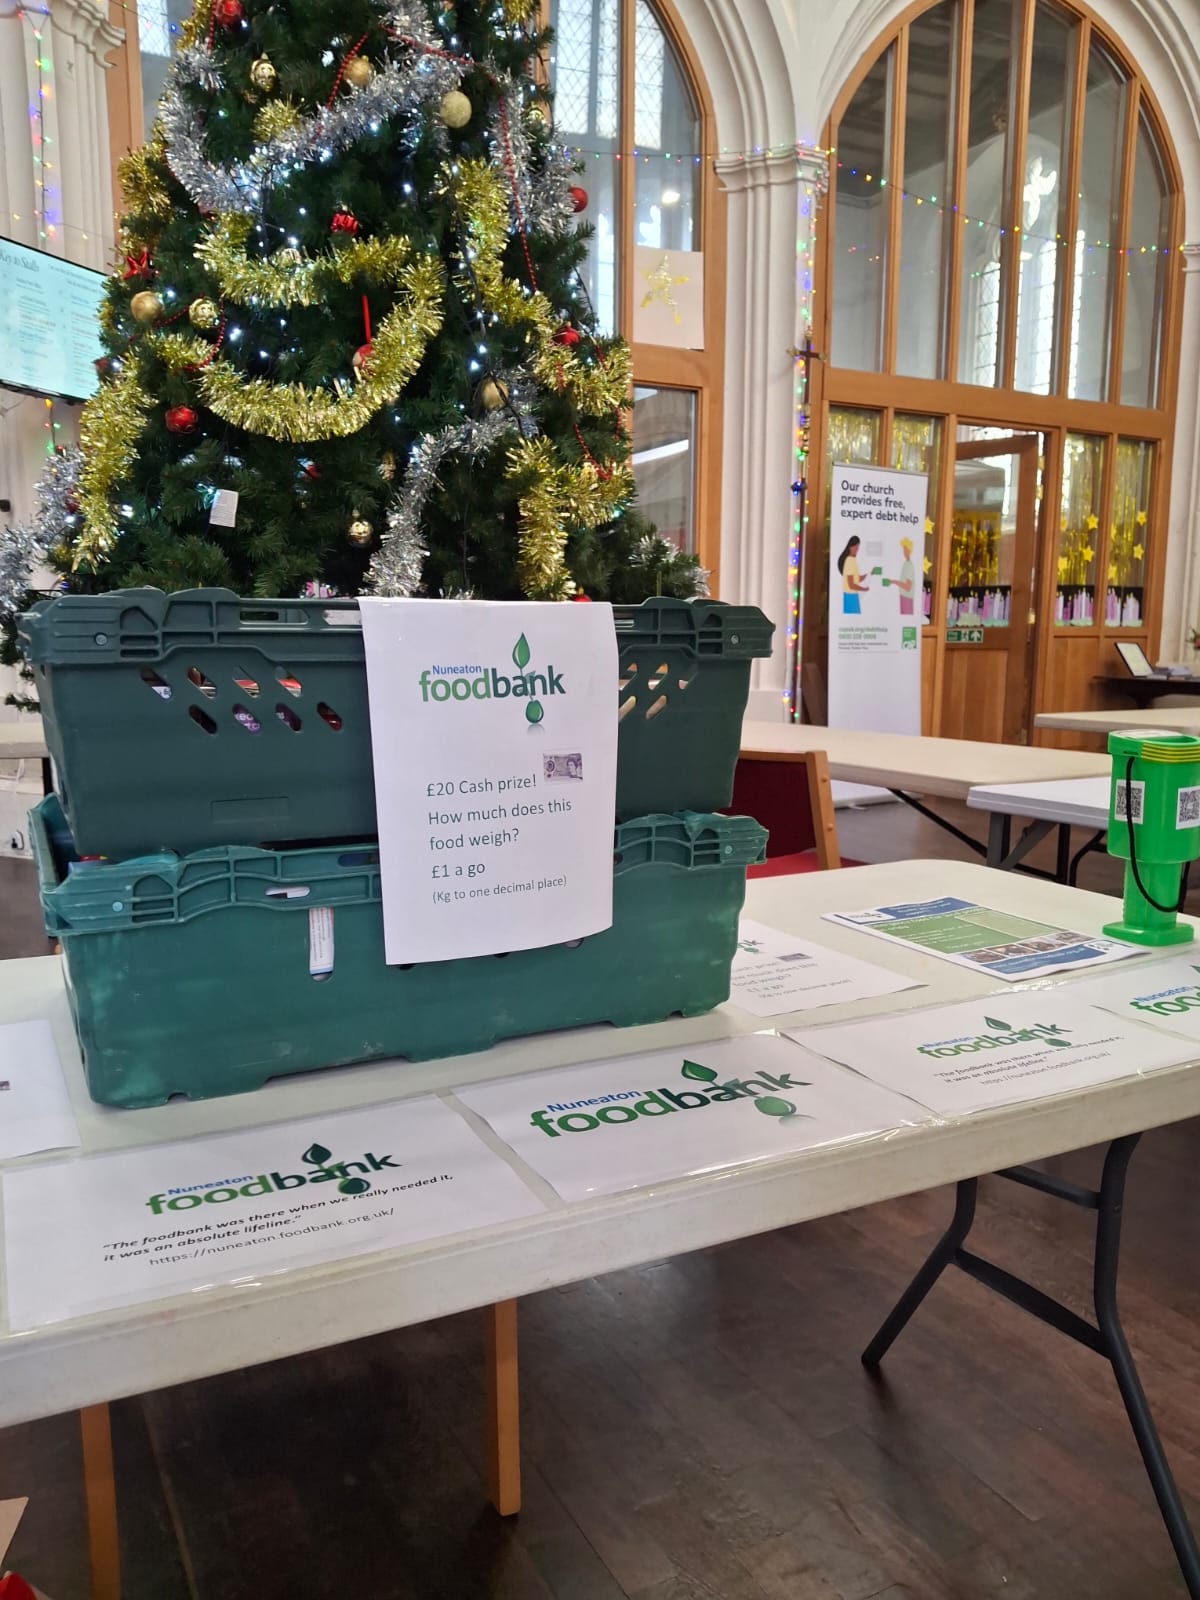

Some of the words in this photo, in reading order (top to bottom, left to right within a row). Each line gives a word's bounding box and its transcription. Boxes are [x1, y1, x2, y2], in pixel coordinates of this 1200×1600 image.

[841, 480, 860, 492] Our
[863, 482, 894, 495] church
[841, 494, 882, 507] provides
[884, 497, 906, 510] free,
[840, 509, 873, 520] expert
[876, 510, 897, 522] debt
[900, 512, 919, 525] help
[432, 664, 482, 676] Nuneaton
[418, 665, 567, 702] foodbank
[426, 781, 455, 797] £20
[459, 778, 493, 794] Cash
[497, 774, 537, 793] prize!
[428, 811, 462, 825] How
[467, 804, 507, 821] much
[511, 803, 544, 817] does
[547, 798, 572, 813] this
[430, 833, 464, 850] food
[468, 828, 520, 847] weigh?
[431, 864, 450, 879] £1
[455, 865, 463, 876] a
[467, 863, 486, 878] go
[432, 891, 451, 904] (Kg
[454, 890, 466, 900] to
[469, 887, 490, 898] one
[493, 880, 534, 895] decimal
[537, 875, 567, 891] place)
[917, 1023, 1073, 1059] foodbank
[922, 1035, 974, 1049] Nuneaton
[530, 1070, 814, 1138] foodbank
[547, 1090, 643, 1113] Nuneaton
[145, 1152, 403, 1216] foodbank
[167, 1175, 254, 1196] Nuneaton
[141, 1224, 213, 1246] foodbank
[216, 1217, 245, 1229] was
[249, 1208, 286, 1222] there
[288, 1201, 326, 1214] when
[329, 1197, 349, 1205] we
[352, 1188, 389, 1200] really
[391, 1176, 438, 1193] needed
[104, 1254, 116, 1262] it
[119, 1249, 150, 1260] was
[154, 1243, 173, 1252] an
[177, 1228, 241, 1248] absolute
[149, 1207, 395, 1267] https://nuneaton.foodbank.org.uk/
